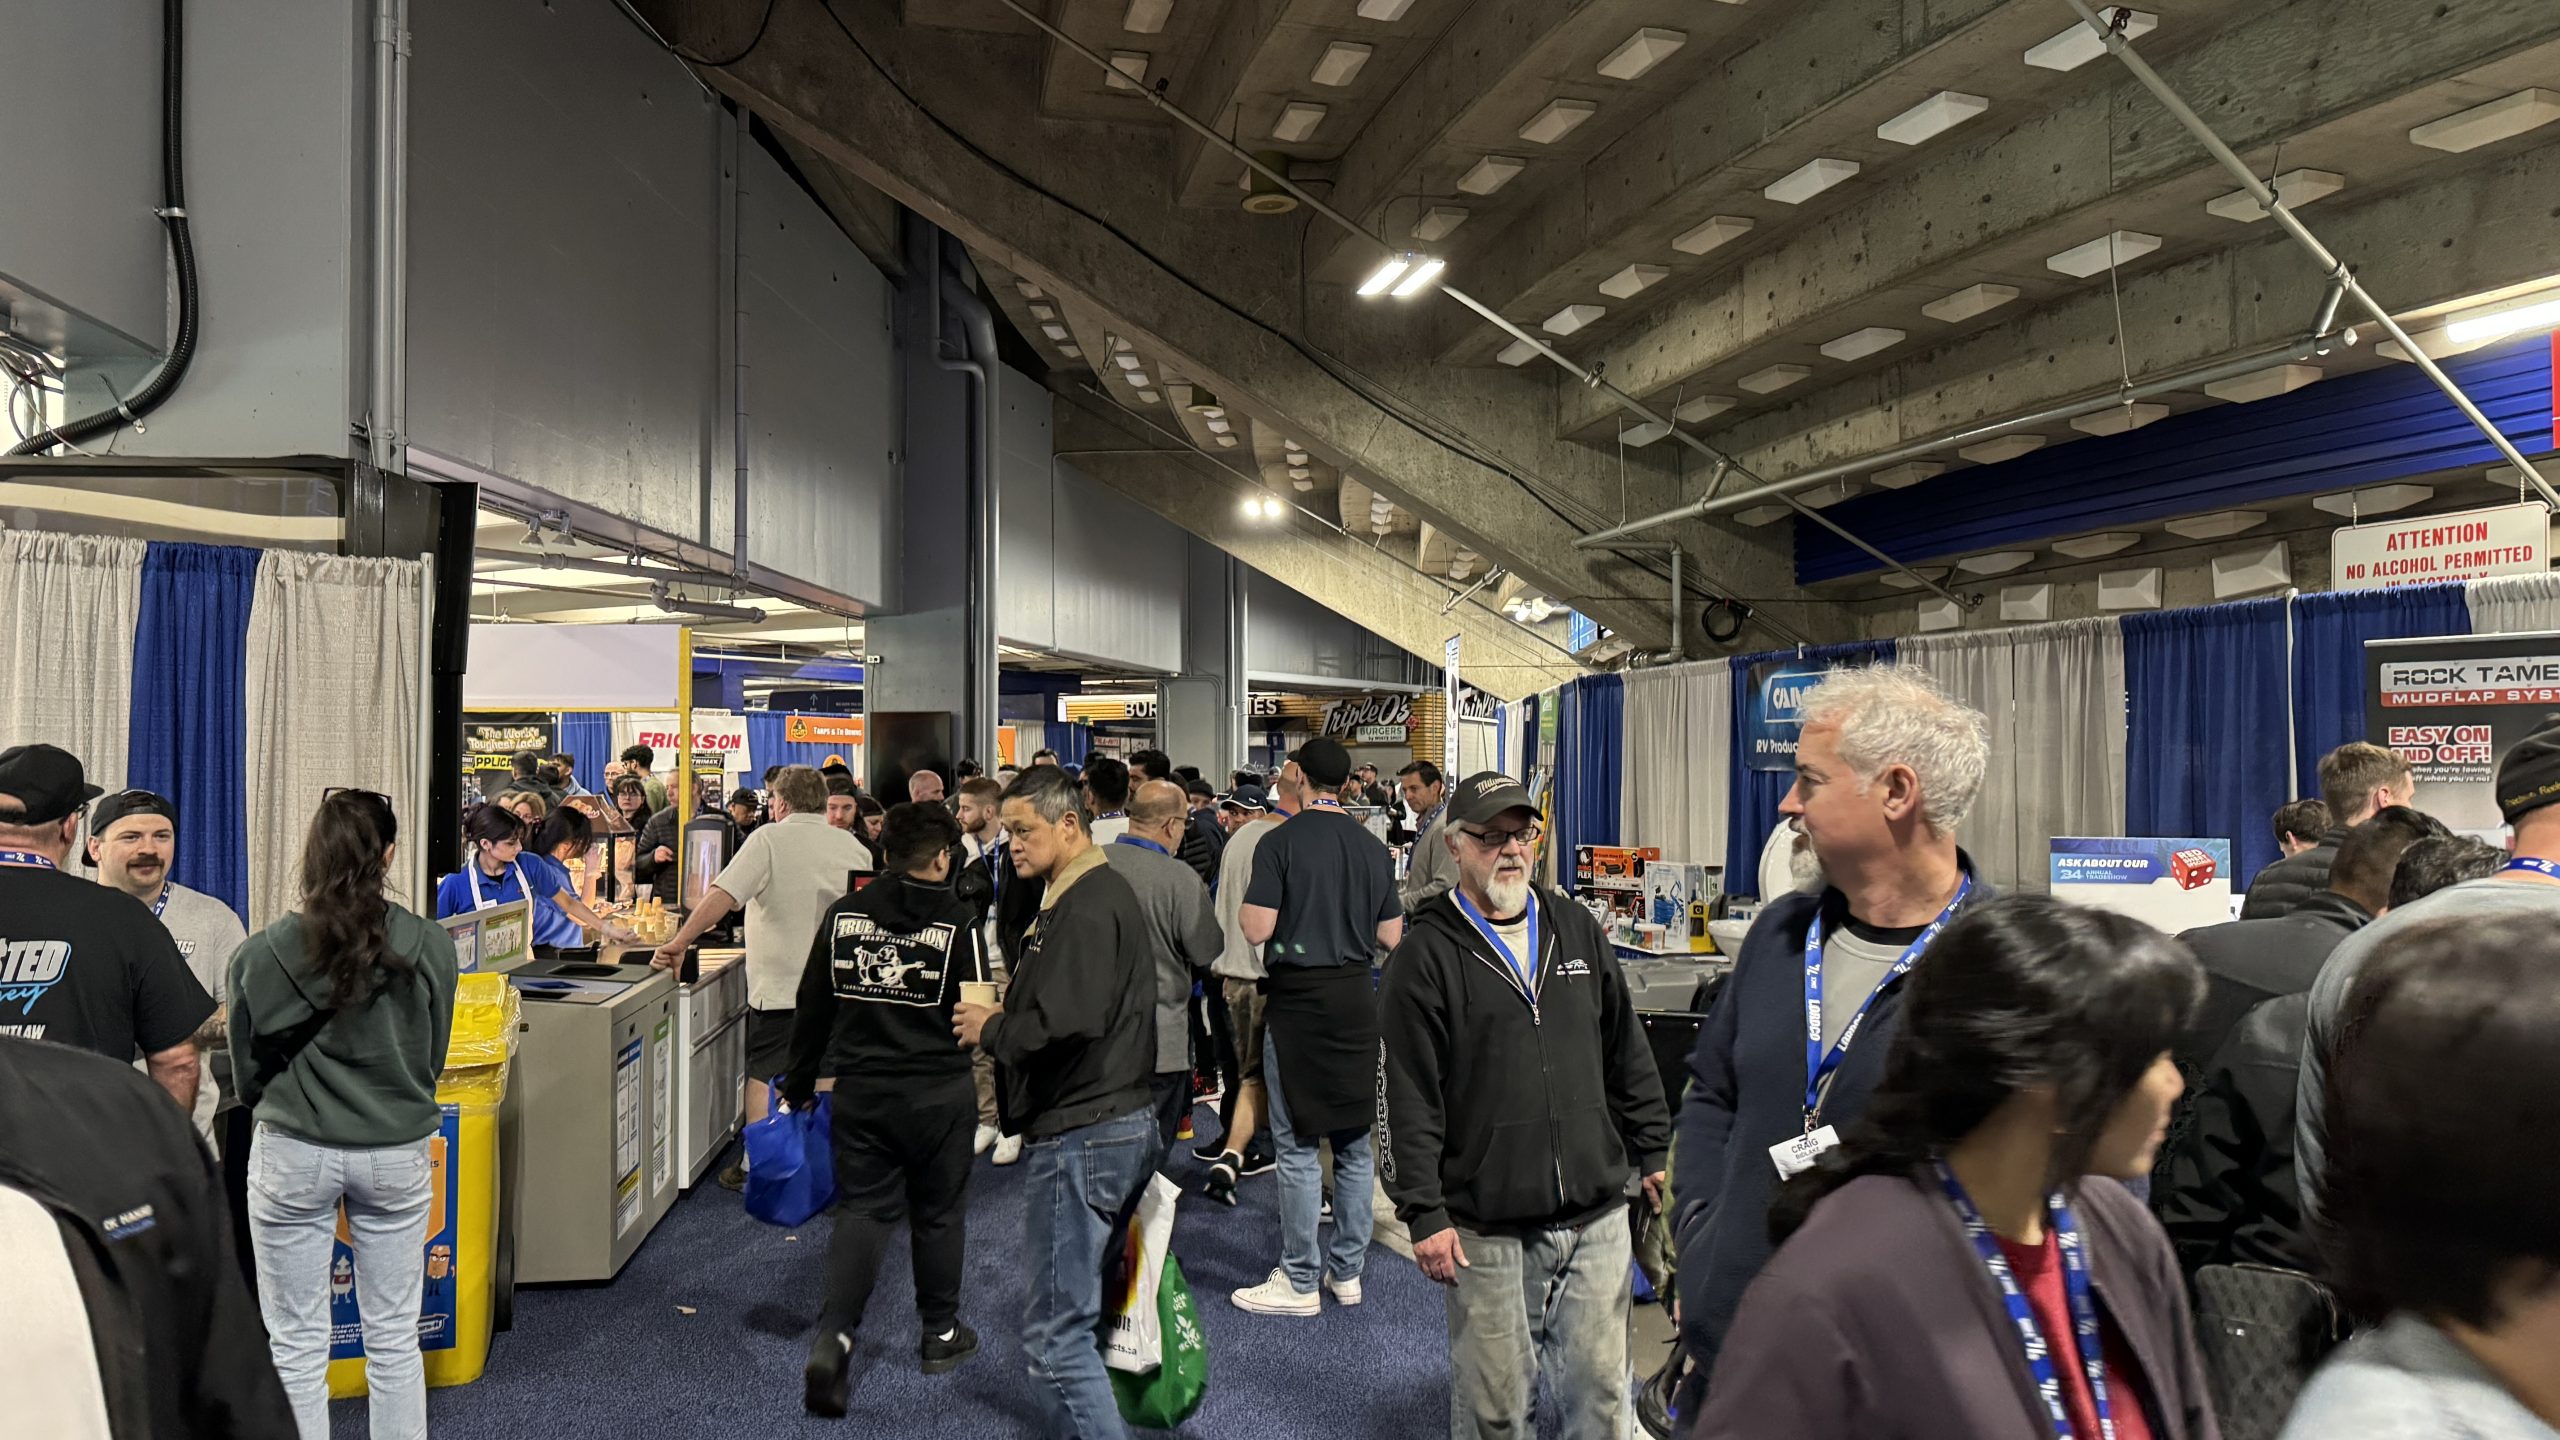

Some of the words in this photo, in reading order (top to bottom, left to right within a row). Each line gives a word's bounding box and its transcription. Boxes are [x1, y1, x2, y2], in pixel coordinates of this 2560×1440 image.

[2386, 521, 2488, 552] ATTENTION
[2346, 563, 2365, 580] NO
[2372, 556, 2437, 578] ALCOHOL
[2444, 545, 2533, 570] PERMITTED
[2393, 667, 2467, 686] ROCK
[2391, 691, 2496, 705] MUDFLAP
[1319, 695, 1378, 739] Triple
[1359, 726, 1403, 736] BURGERS
[2388, 725, 2453, 745] EASY
[2453, 725, 2492, 745] ON
[1756, 739, 1769, 753] RV
[2436, 746, 2492, 764] OFF!
[2424, 774, 2446, 782] when
[2434, 766, 2460, 774] you're
[2057, 858, 2082, 867] ASK
[2082, 858, 2122, 868] ABOUT
[2123, 859, 2149, 868] OUR
[1577, 870, 1592, 879] FLEX
[837, 919, 875, 936] TRUE
[920, 970, 940, 980] TOUR
[1808, 998, 1820, 1041] LORDCO
[1791, 1138, 1819, 1154] CRAIG
